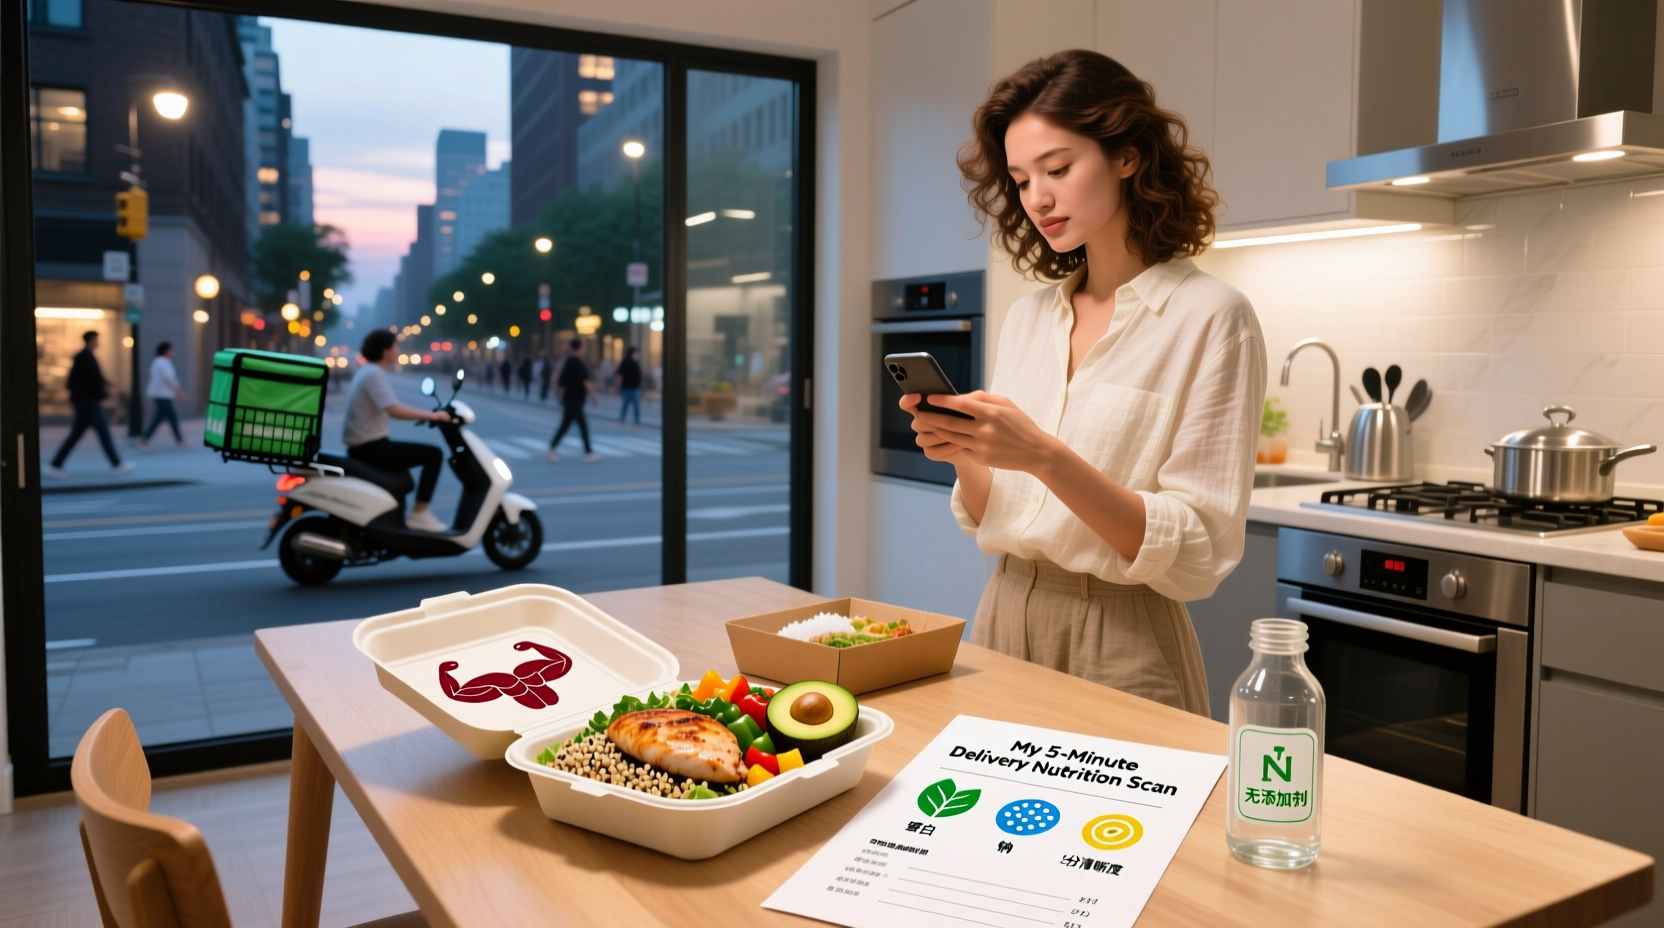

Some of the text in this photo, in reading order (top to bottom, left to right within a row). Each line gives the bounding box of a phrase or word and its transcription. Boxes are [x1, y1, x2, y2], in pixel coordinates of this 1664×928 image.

[949, 745, 1178, 796] Delivery Nutrition Scan
[1010, 740, 1139, 771] My 5-Minute
